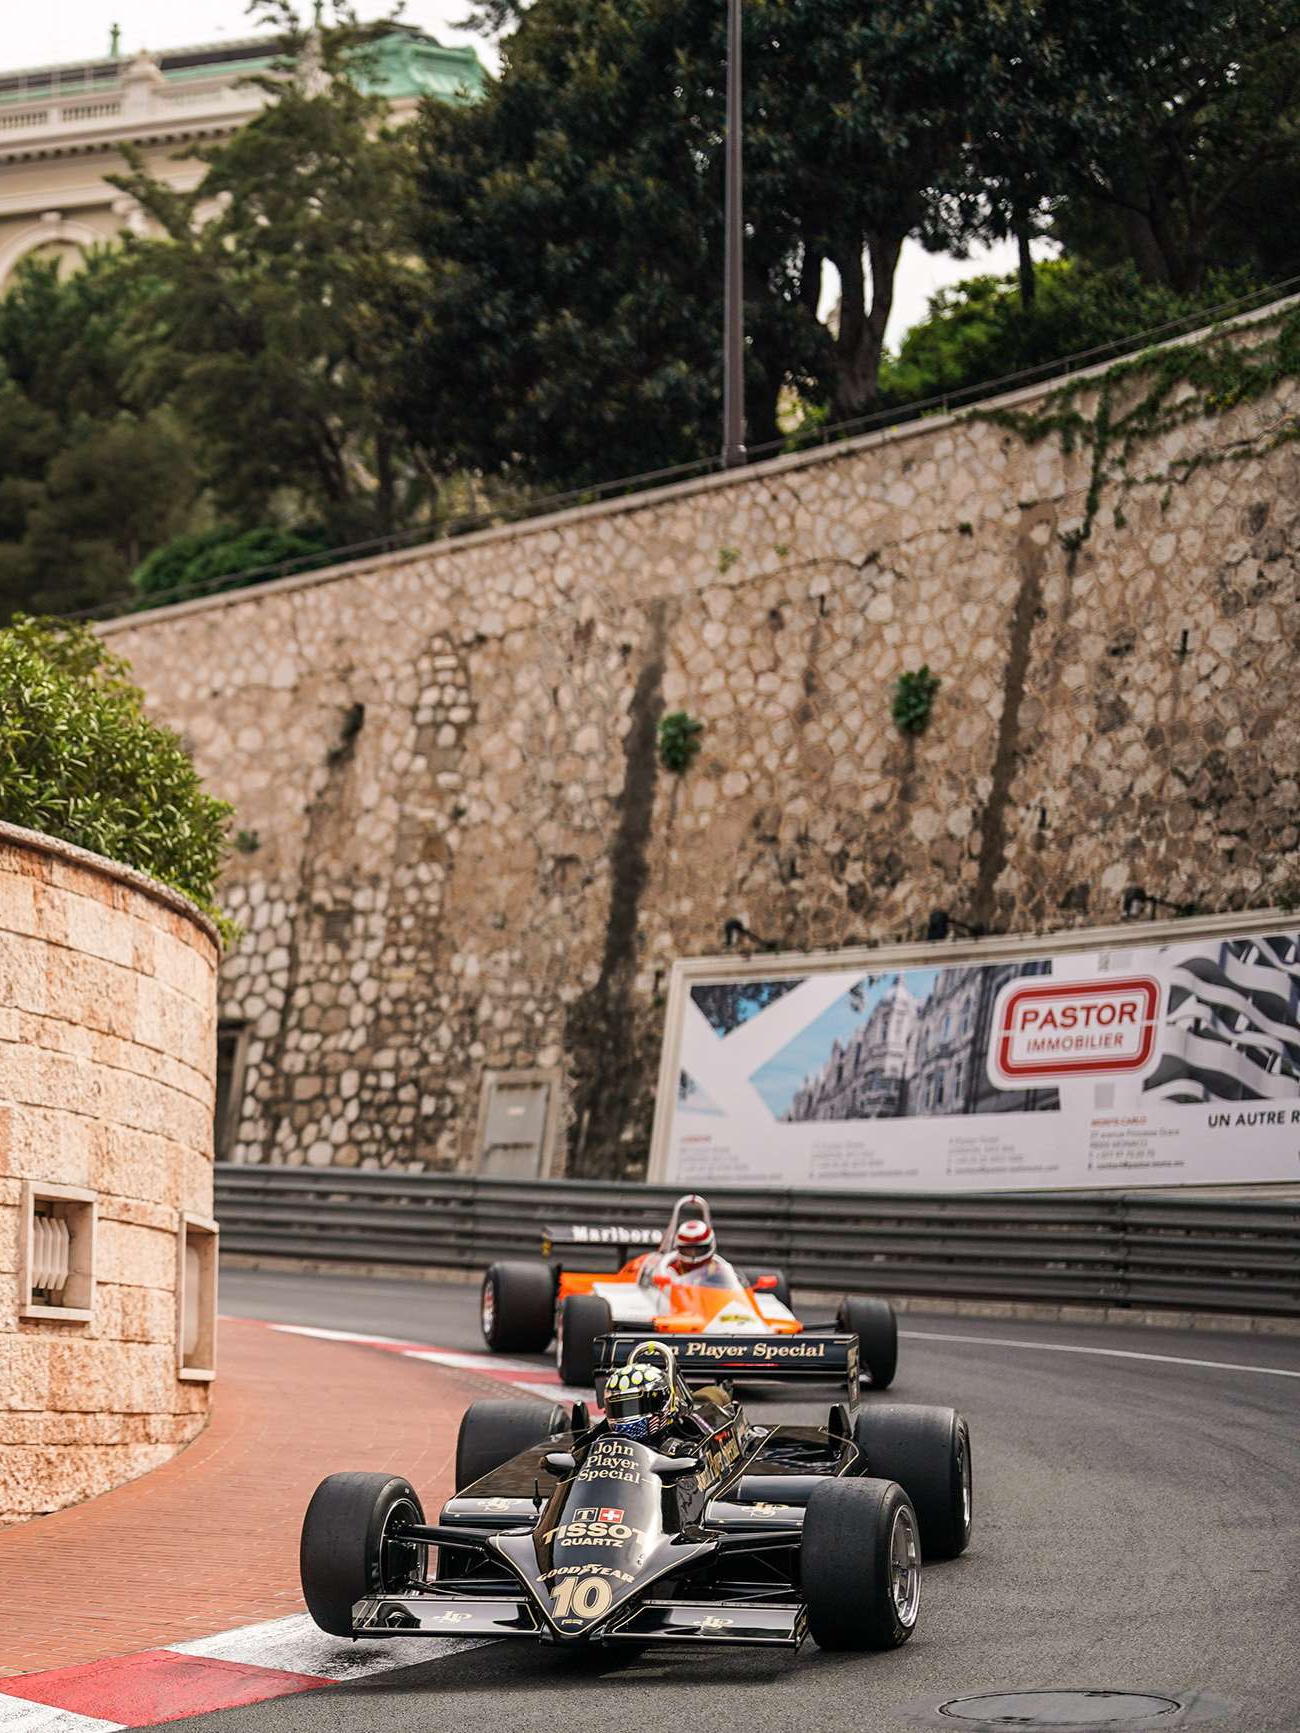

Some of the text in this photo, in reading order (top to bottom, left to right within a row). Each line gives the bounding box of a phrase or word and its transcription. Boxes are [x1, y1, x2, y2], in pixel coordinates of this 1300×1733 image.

[1020, 1002, 1137, 1031] PASTOR
[1027, 1032, 1124, 1053] IMMOBILIER
[1208, 1113, 1230, 1128] UN
[1235, 1110, 1286, 1126] AUTRE
[571, 1225, 662, 1242] Marlboro
[685, 1342, 747, 1359] Player
[753, 1342, 825, 1360] Special
[594, 1441, 634, 1456] John
[586, 1455, 639, 1470] Player
[577, 1468, 640, 1484] Special
[542, 1522, 646, 1545] TISSOT
[561, 1537, 624, 1547] QUARTZ
[536, 1563, 635, 1583] GOODYEAR
[550, 1576, 613, 1619] 10
